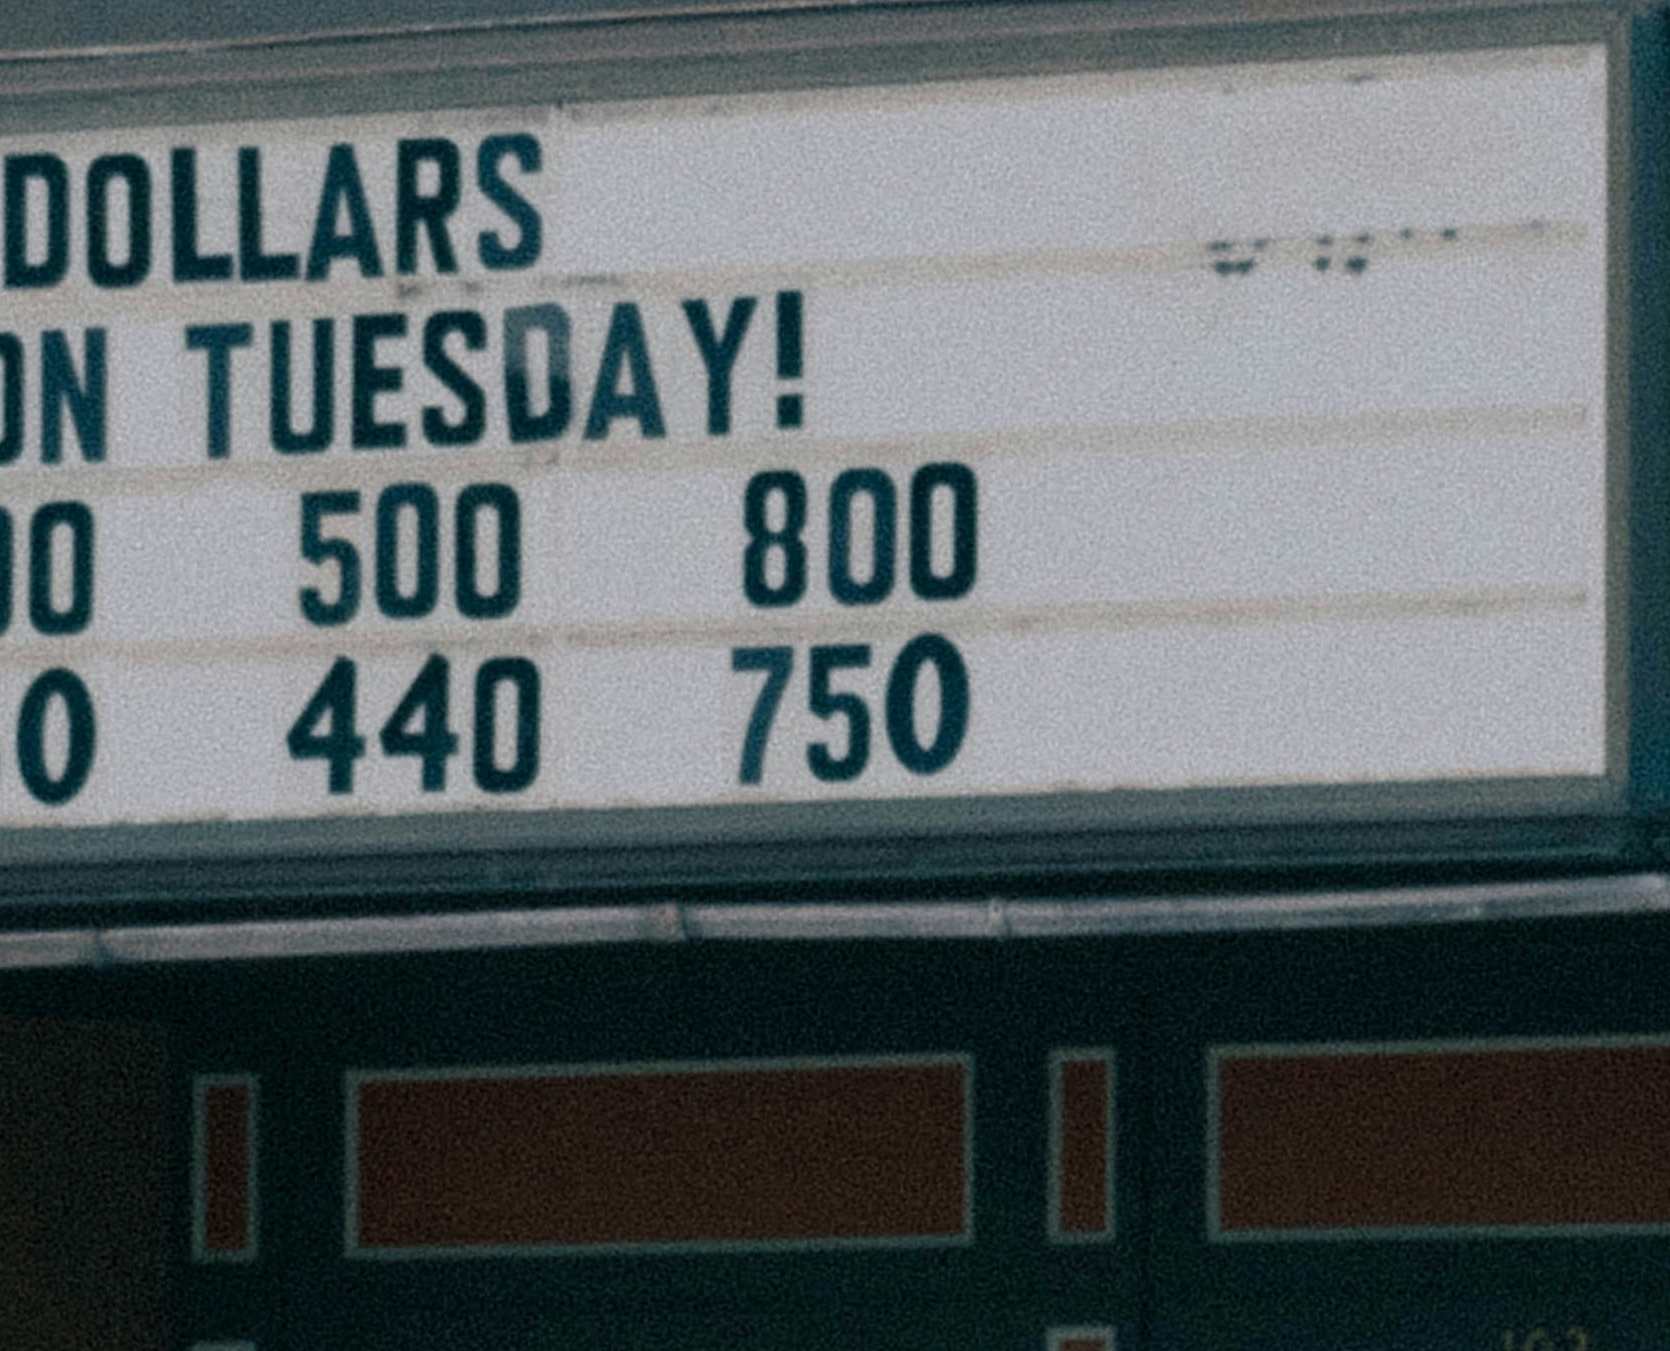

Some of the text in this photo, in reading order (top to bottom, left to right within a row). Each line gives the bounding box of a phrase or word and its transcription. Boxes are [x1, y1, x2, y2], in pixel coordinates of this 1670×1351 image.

[2, 130, 542, 291] DOLLARS
[184, 289, 805, 460] TUESDAY!
[298, 481, 522, 628] 500
[742, 460, 979, 609] 800
[285, 650, 542, 796] 440
[731, 631, 971, 785] 750
